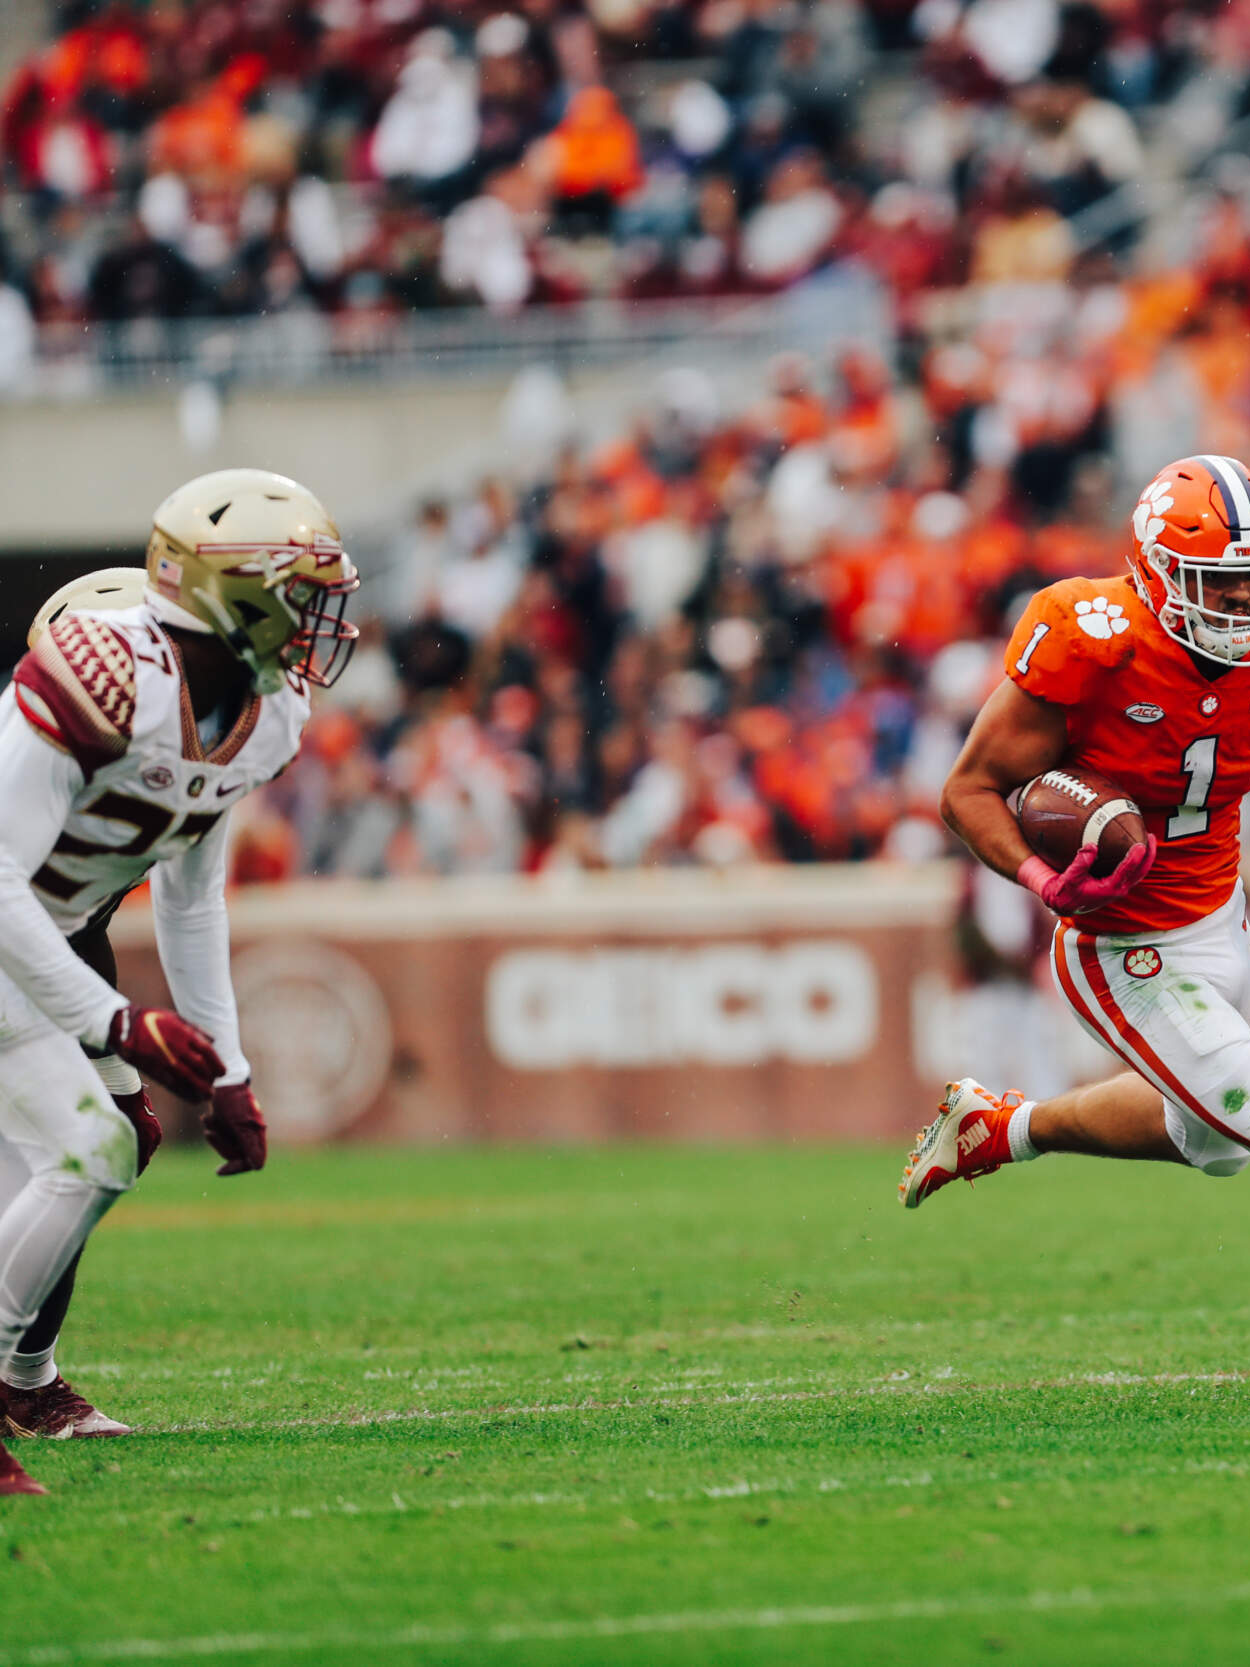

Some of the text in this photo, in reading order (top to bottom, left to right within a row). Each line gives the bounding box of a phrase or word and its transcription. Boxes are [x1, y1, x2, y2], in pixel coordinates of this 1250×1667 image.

[1015, 622, 1051, 675] 1
[1129, 707, 1161, 717] ACC
[1164, 734, 1220, 842] 1
[954, 1116, 992, 1156] NIKE
